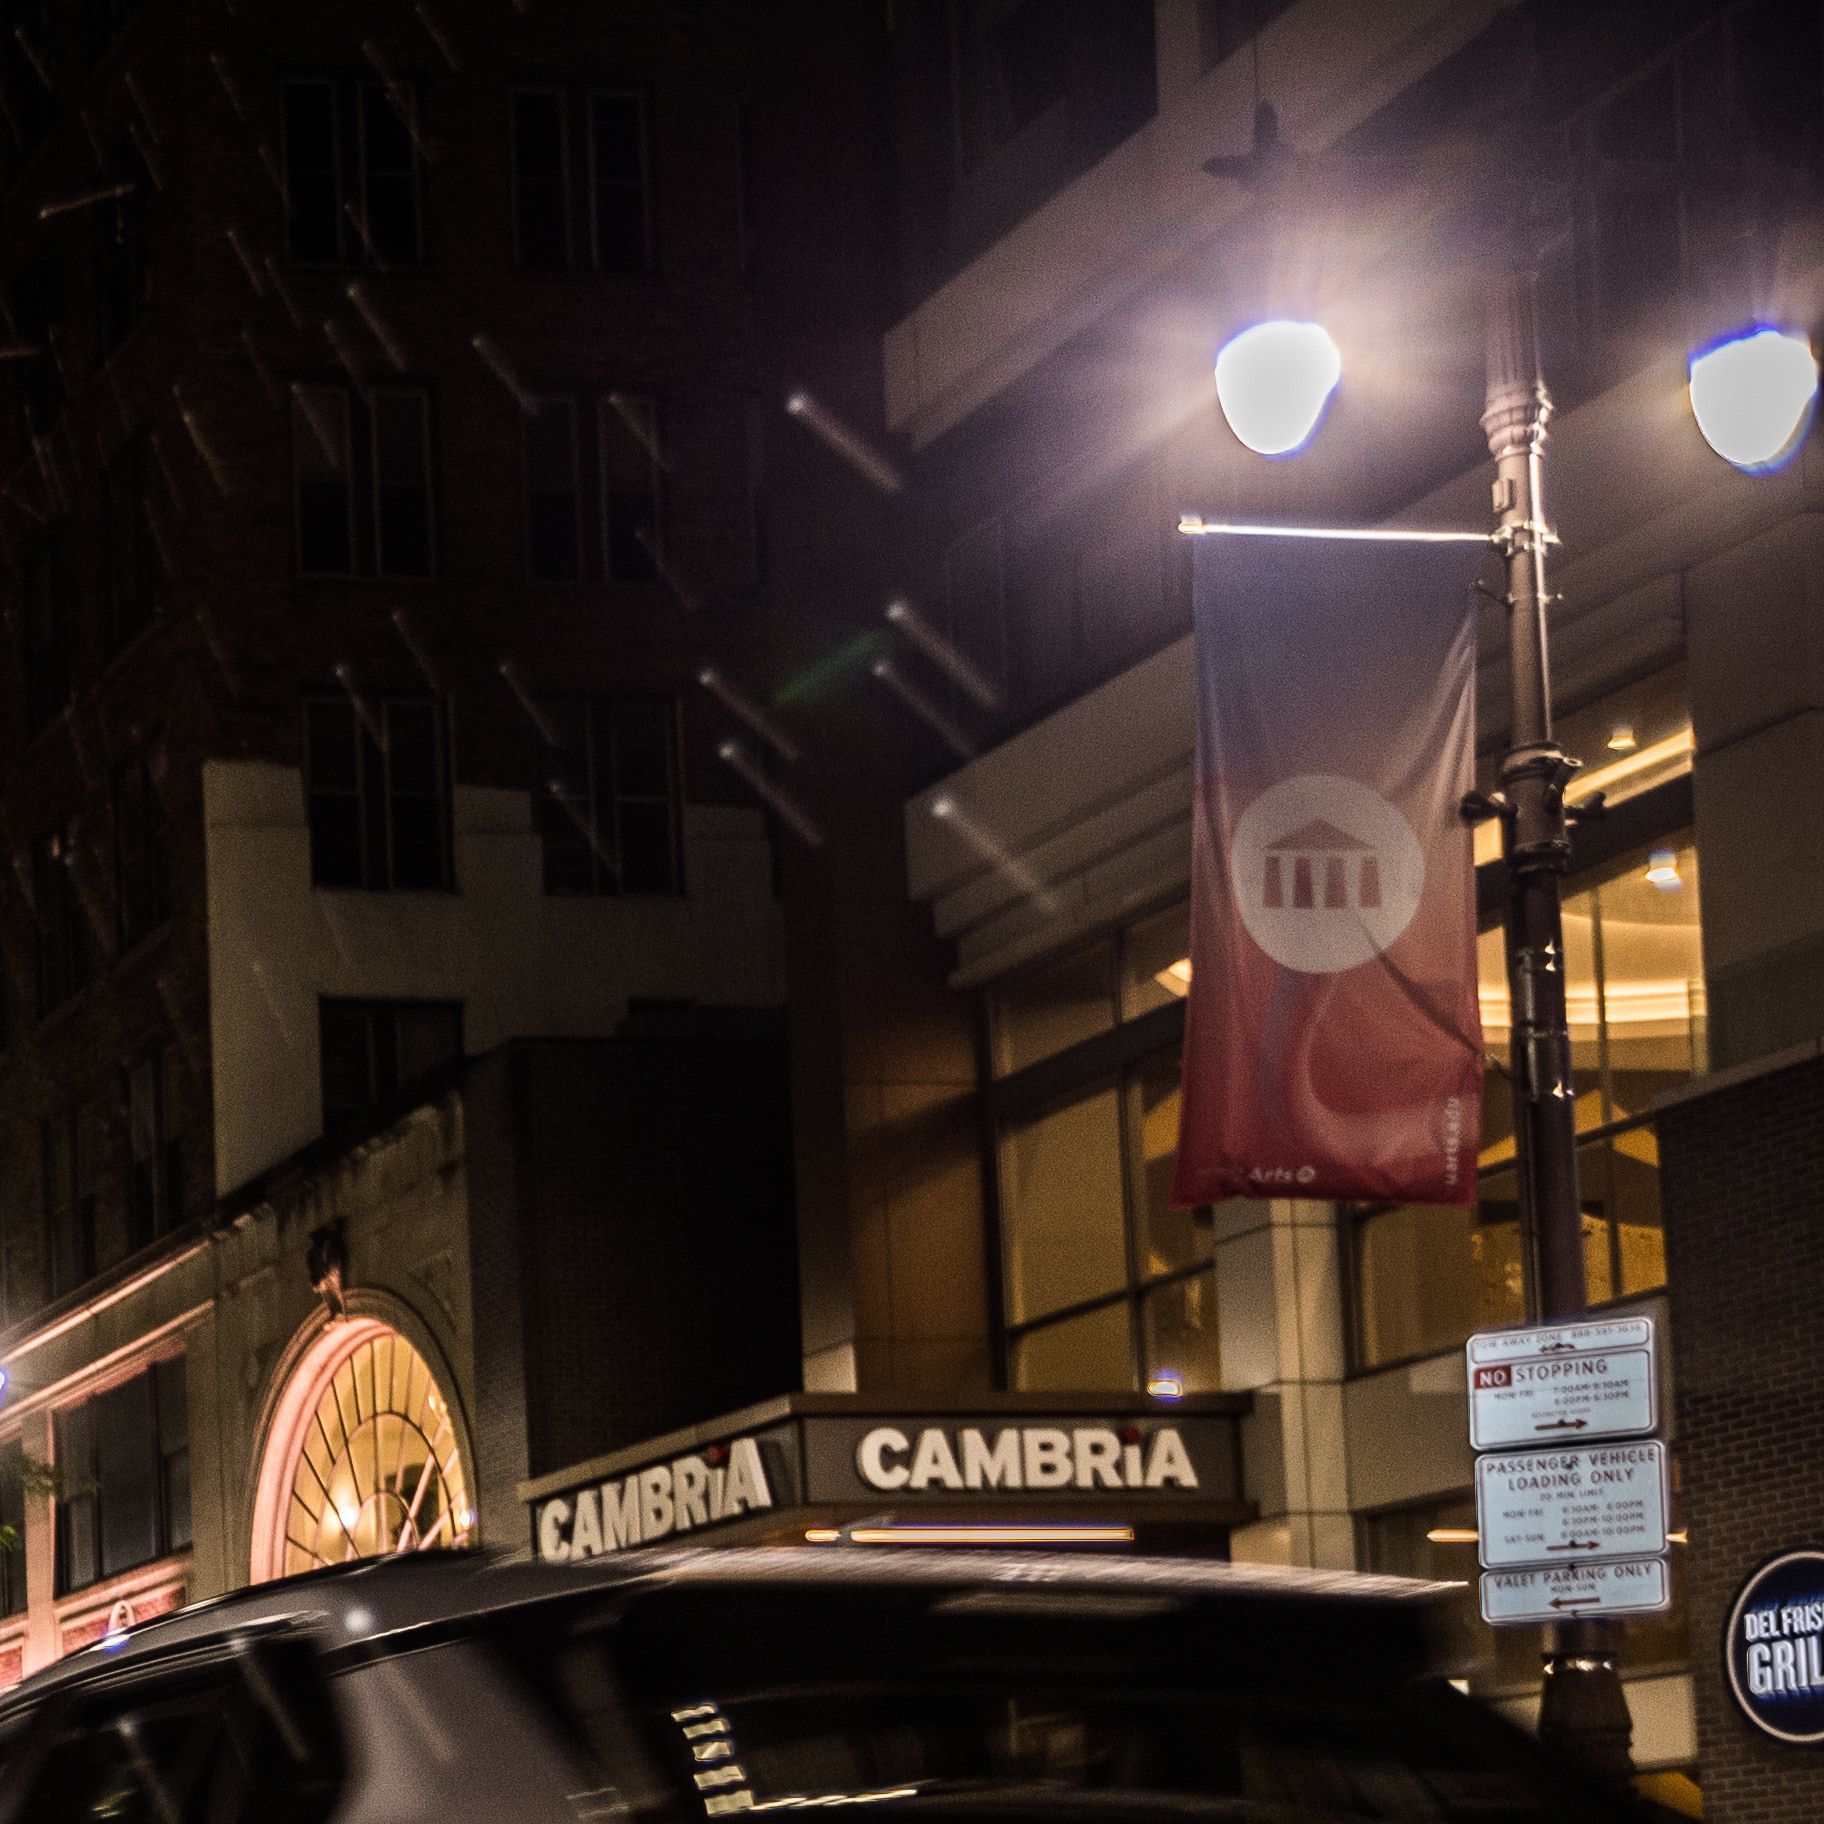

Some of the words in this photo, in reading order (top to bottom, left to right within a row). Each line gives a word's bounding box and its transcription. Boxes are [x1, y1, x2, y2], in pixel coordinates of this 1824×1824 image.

[1479, 1369, 1508, 1387] NO
[1516, 1360, 1608, 1382] STOPPING
[1486, 1455, 1581, 1474] PASSENGER
[1588, 1449, 1655, 1466] VEHICLE
[1508, 1473, 1581, 1491] LOADING
[1590, 1468, 1634, 1484] ONLY
[1556, 1490, 1574, 1500] MIN
[1579, 1488, 1604, 1499] LIMIT
[1494, 1573, 1536, 1589] VALET
[1543, 1566, 1607, 1584] PARKING
[1614, 1563, 1652, 1579] ONLY
[1744, 1609, 1781, 1642] DEL
[1780, 1601, 1824, 1637] FRIS
